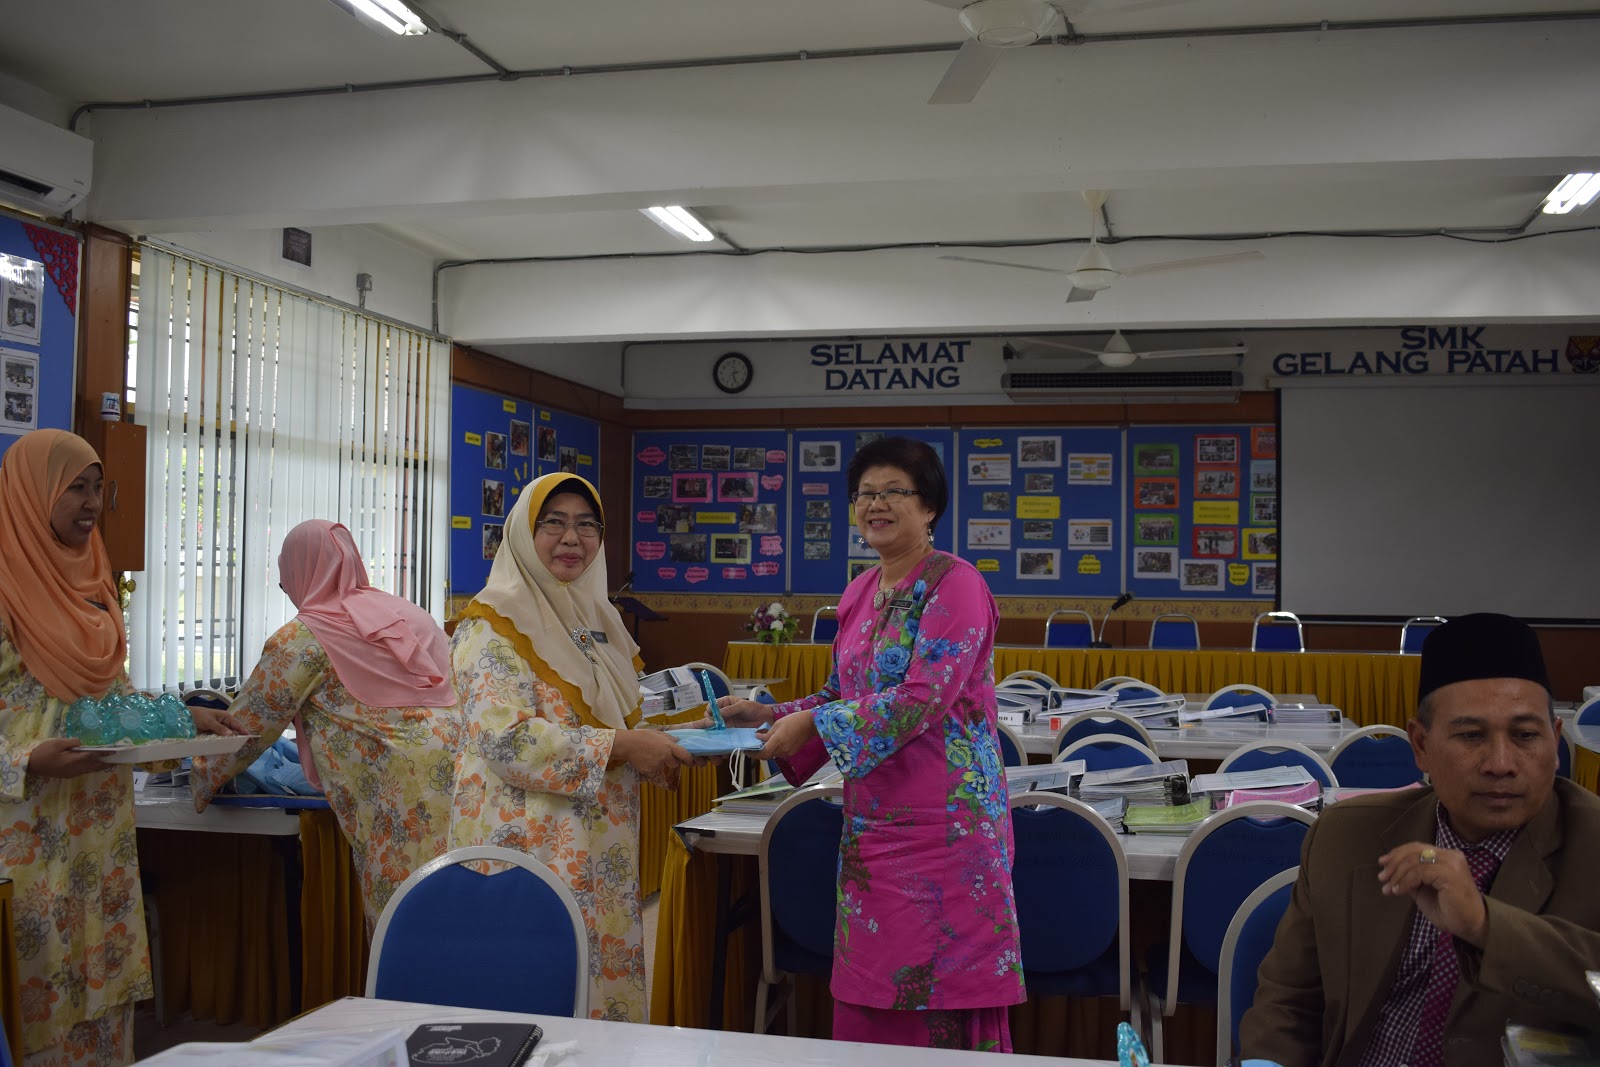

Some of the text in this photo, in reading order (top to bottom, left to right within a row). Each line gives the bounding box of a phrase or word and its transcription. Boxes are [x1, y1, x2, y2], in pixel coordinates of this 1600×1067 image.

[1400, 326, 1486, 350] SMK
[810, 340, 971, 366] SELAMAT
[1273, 349, 1560, 376] GELANG PATAH
[825, 366, 960, 390] DATANG
